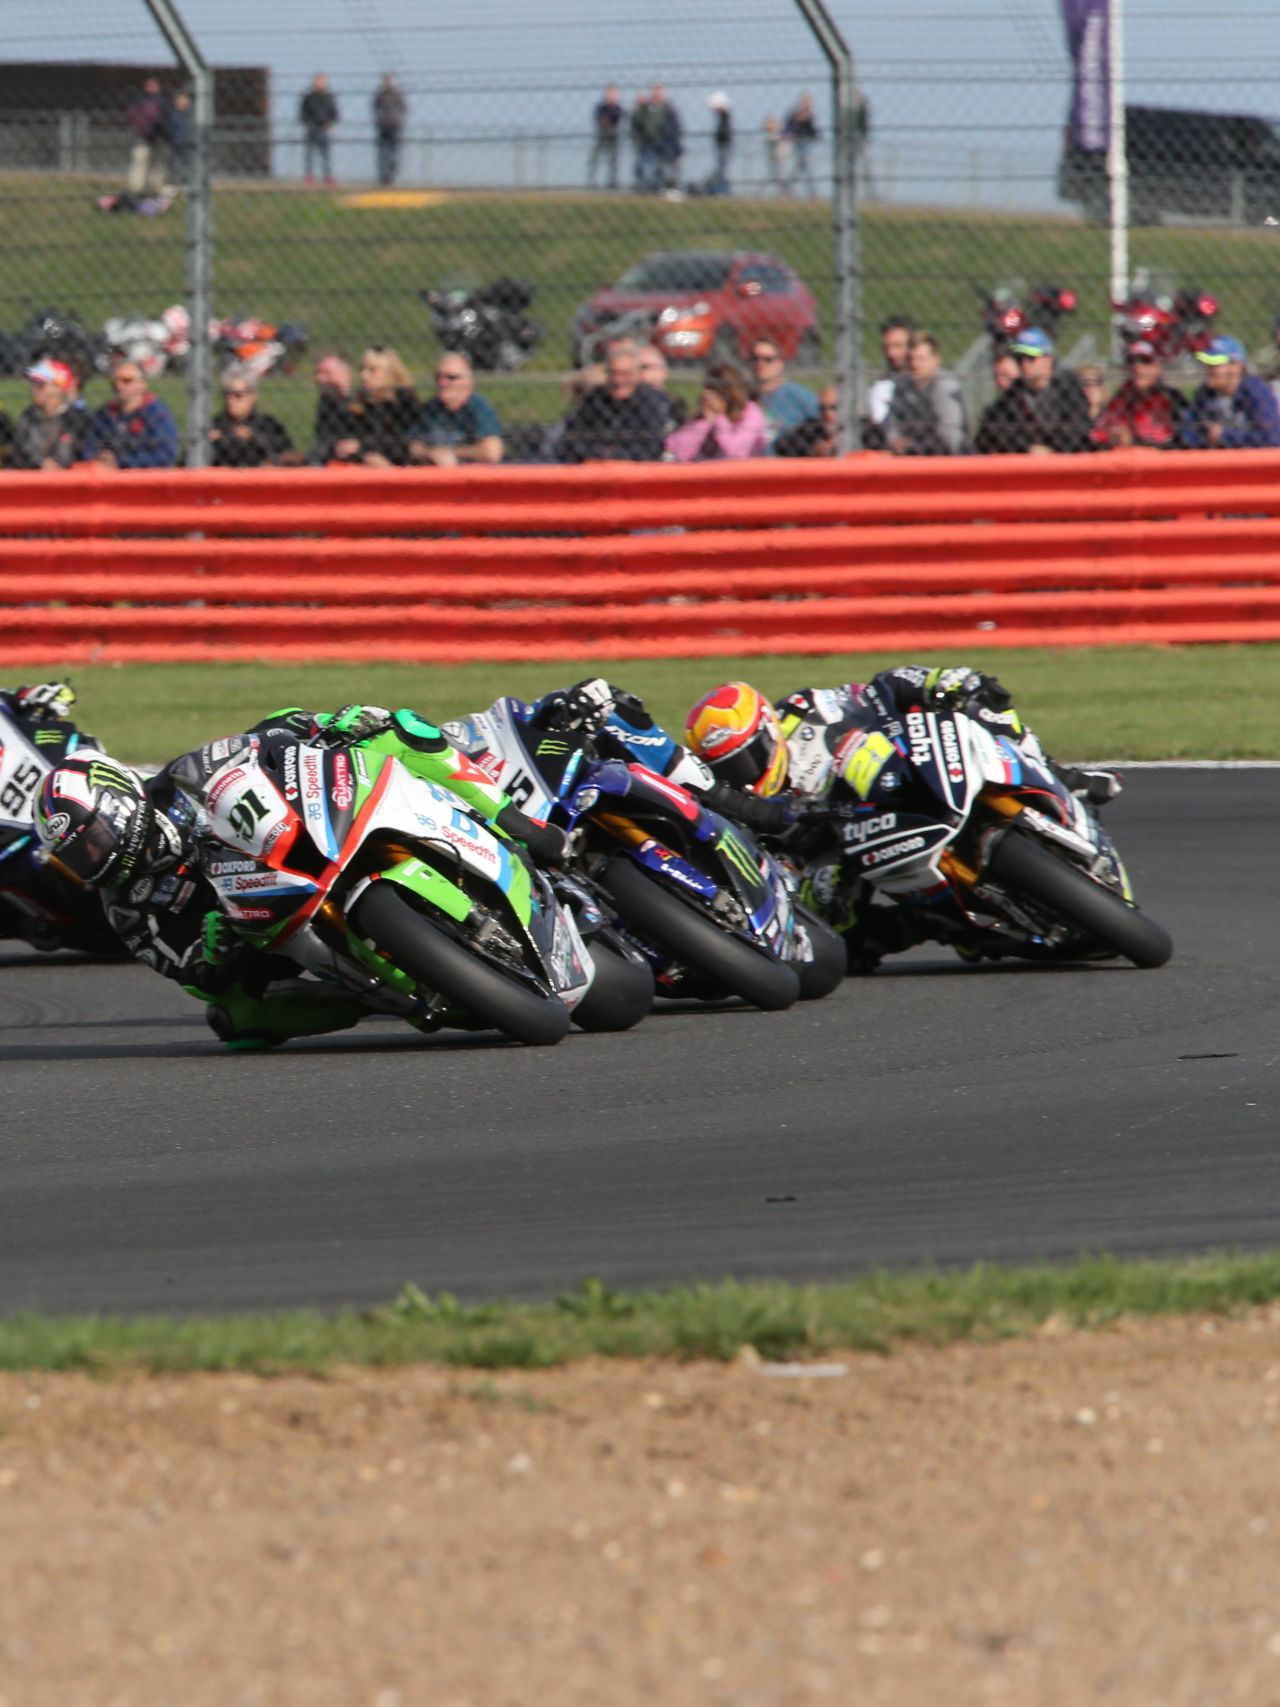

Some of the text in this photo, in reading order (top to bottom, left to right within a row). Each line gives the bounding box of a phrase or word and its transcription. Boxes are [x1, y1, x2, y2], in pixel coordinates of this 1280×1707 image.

[283, 745, 297, 783] OXFORD
[844, 730, 897, 801] 21
[905, 712, 932, 767] tyco
[0, 760, 42, 817] 95
[303, 754, 322, 799] Speedfit
[336, 755, 349, 808] QUATTRO
[226, 788, 271, 844] 91
[842, 812, 897, 842] tyco
[441, 824, 497, 864] Speedfit
